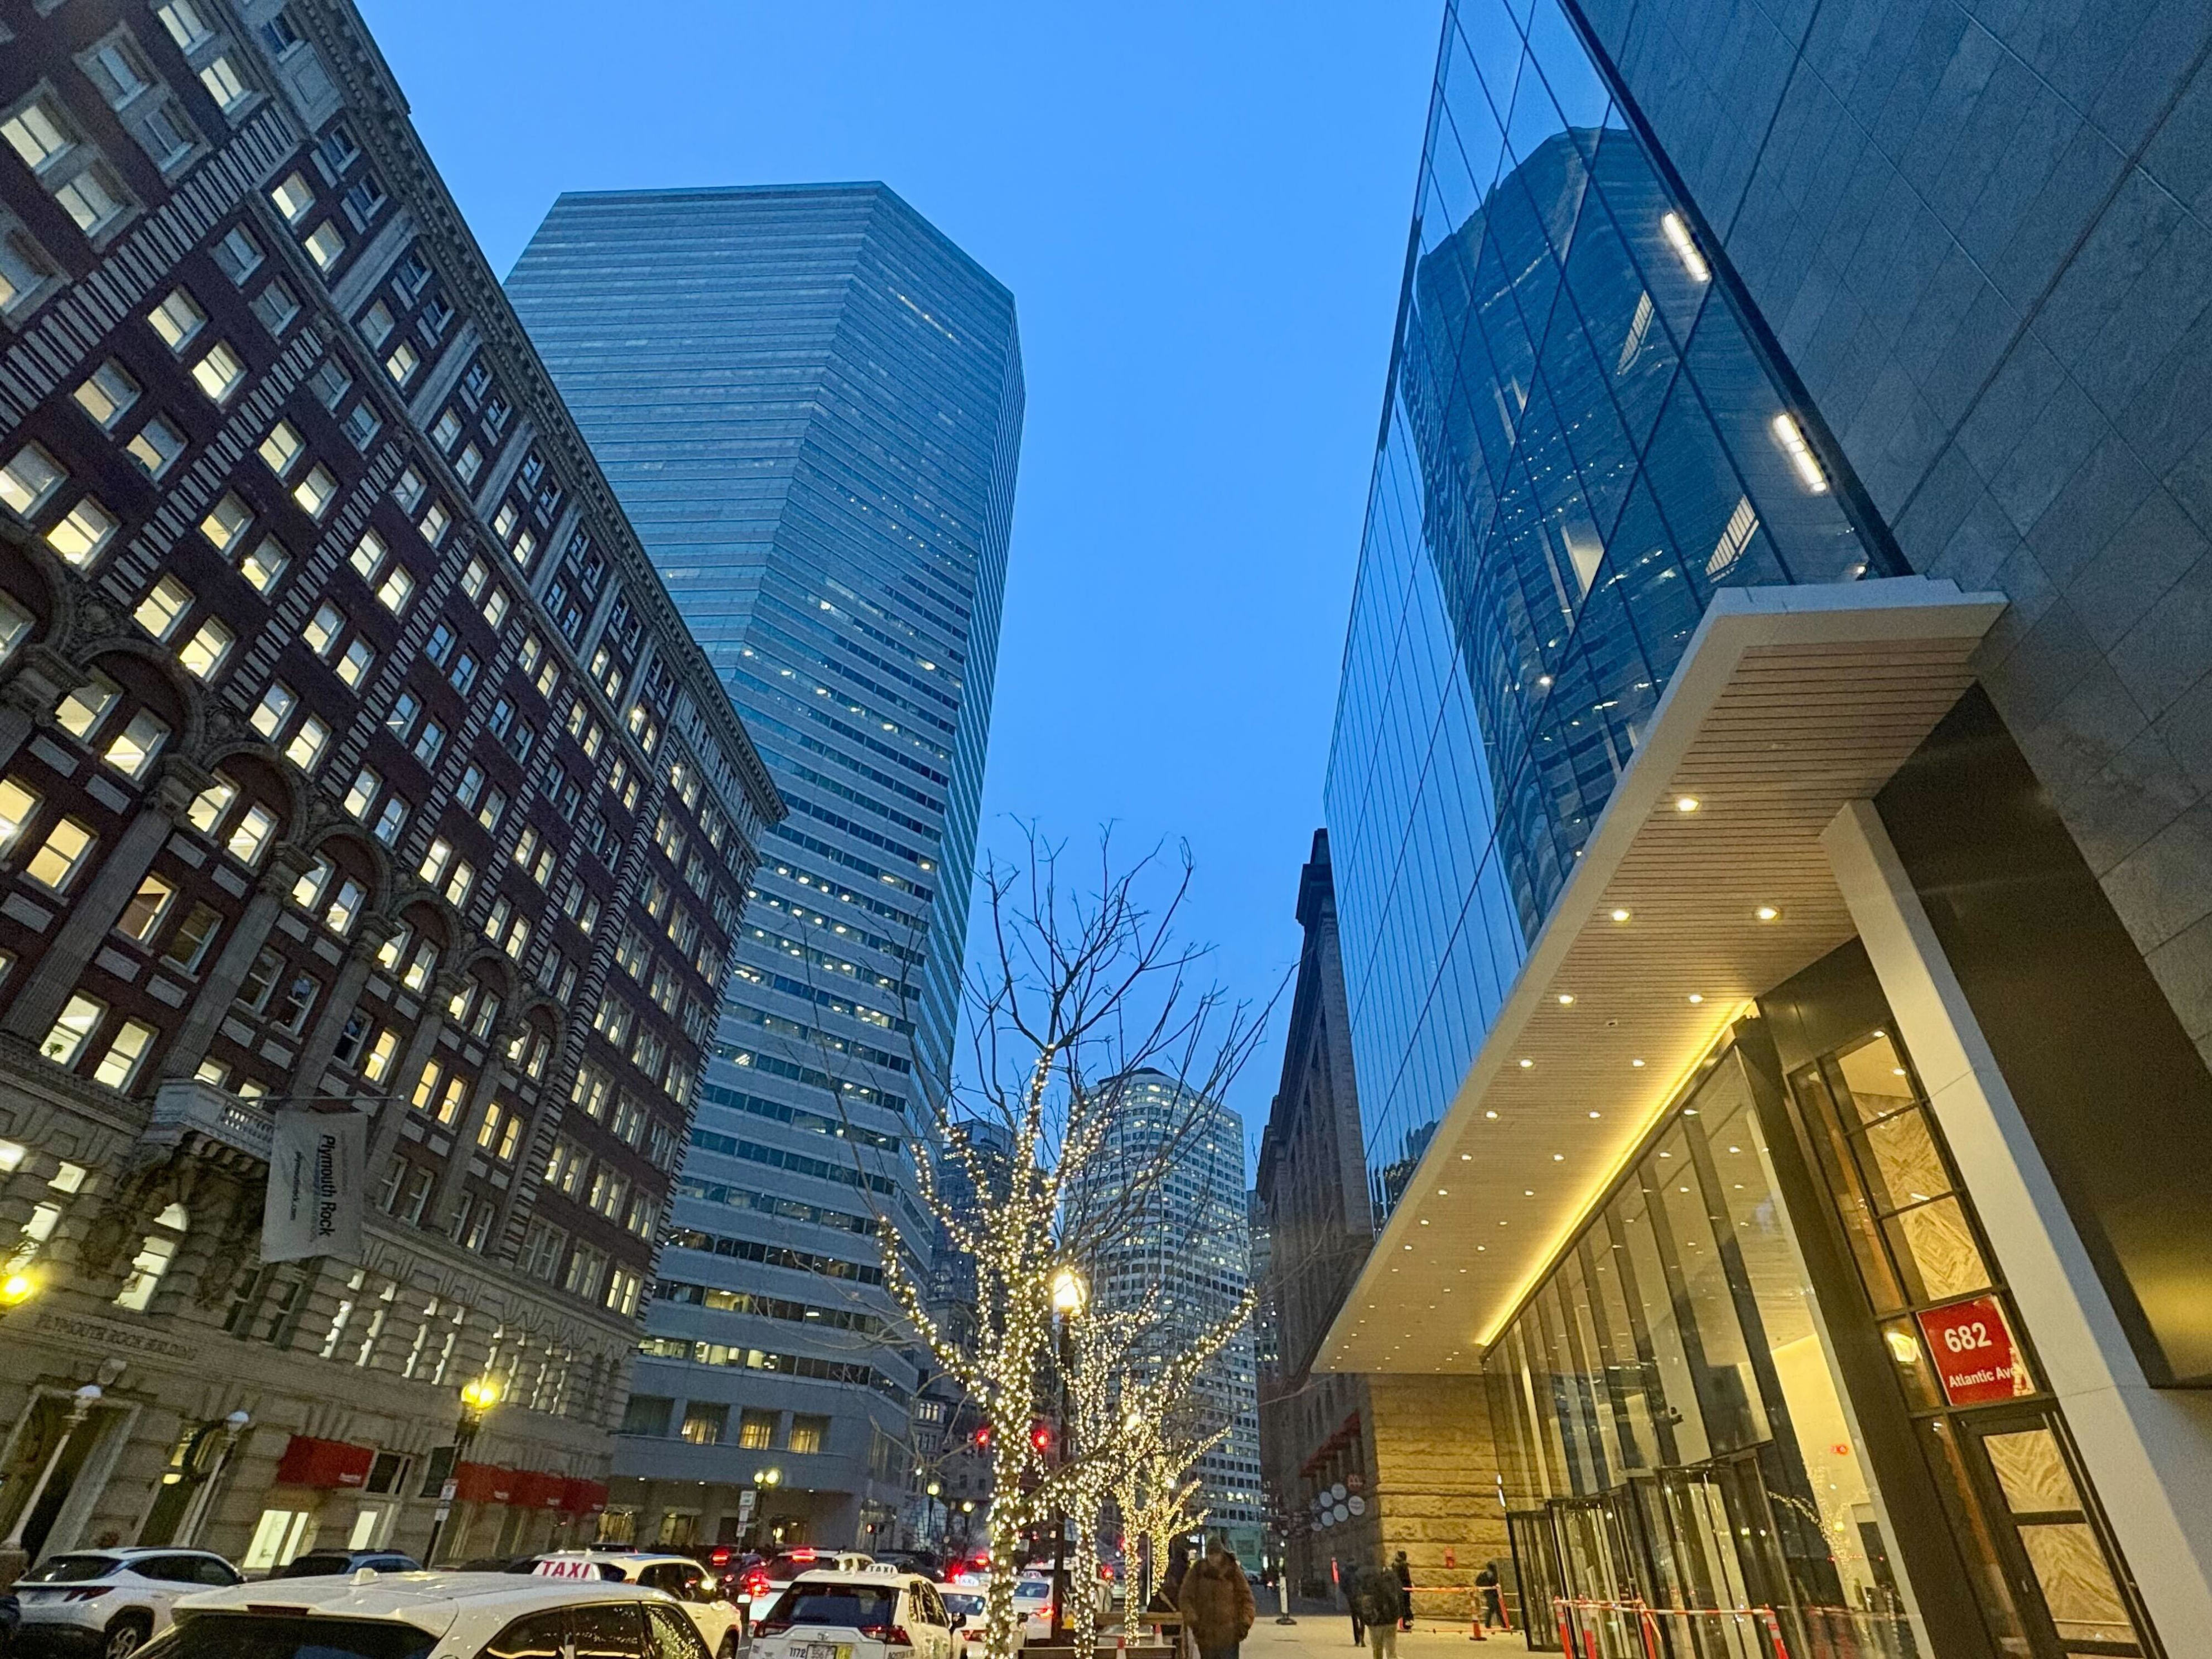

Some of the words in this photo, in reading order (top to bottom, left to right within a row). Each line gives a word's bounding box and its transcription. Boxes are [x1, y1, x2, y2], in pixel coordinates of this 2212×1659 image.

[318, 1134, 337, 1197] Plymouth
[319, 1202, 337, 1238] Rock
[1944, 1322, 1993, 1353] 682
[1949, 1369, 1995, 1388] Atlantic
[543, 1561, 591, 1579] TAXI
[789, 1647, 806, 1658] 1172
